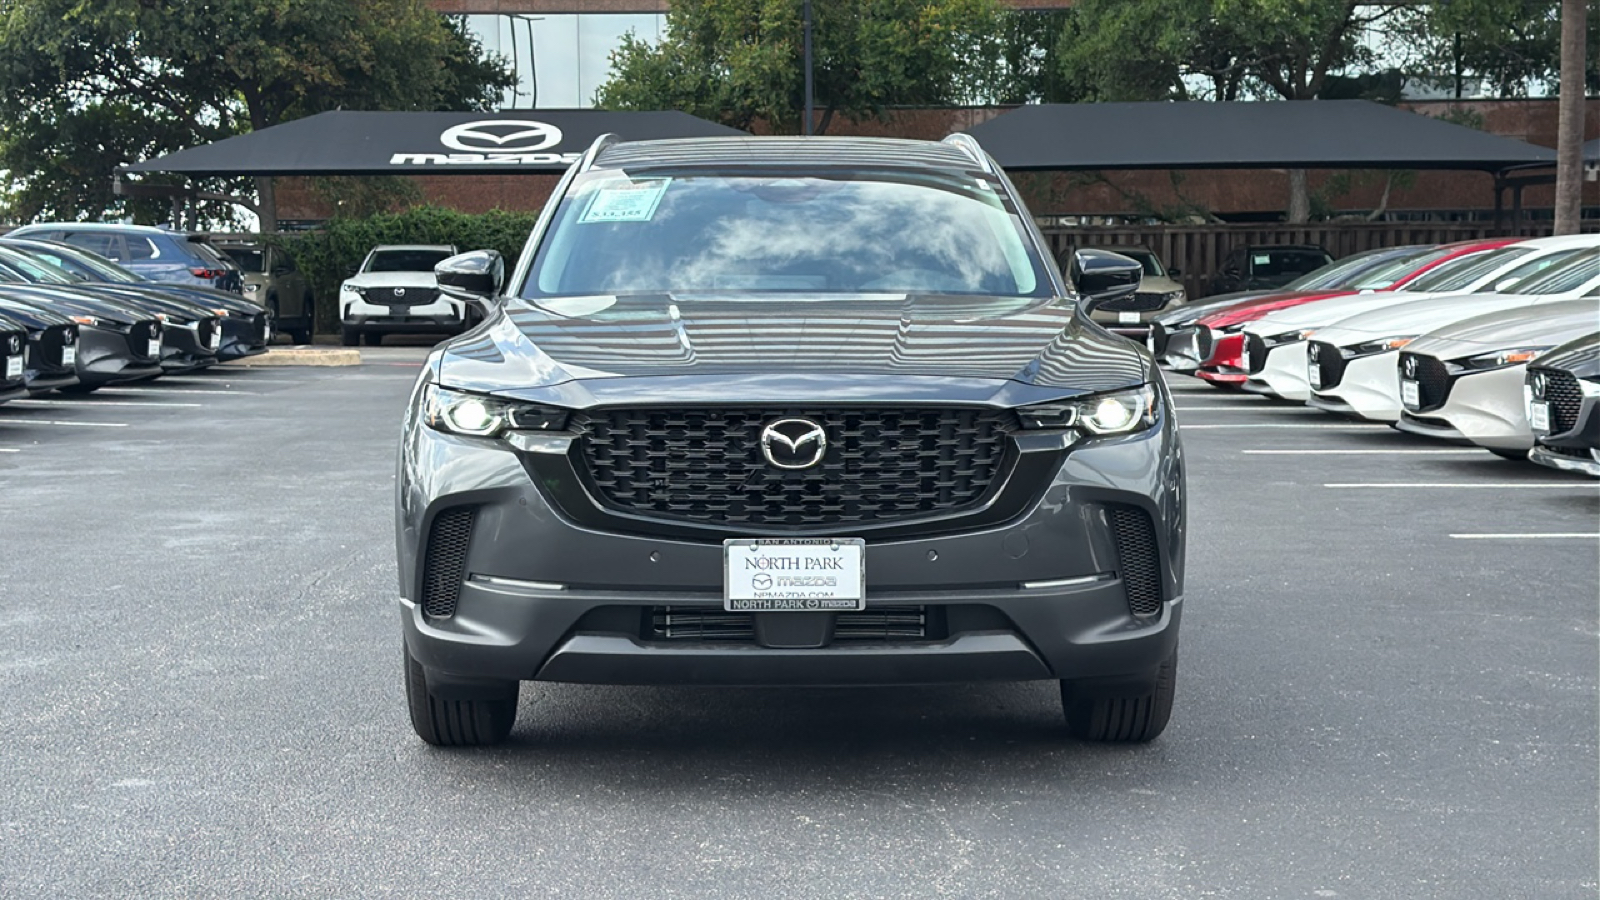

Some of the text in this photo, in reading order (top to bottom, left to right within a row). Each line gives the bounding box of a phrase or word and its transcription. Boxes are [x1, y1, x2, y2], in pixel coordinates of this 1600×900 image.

[745, 556, 844, 570] NORTH PARK
[753, 591, 835, 599] NPMAZDACOM
[733, 600, 771, 610] NORTH
[774, 600, 805, 610] PARK
